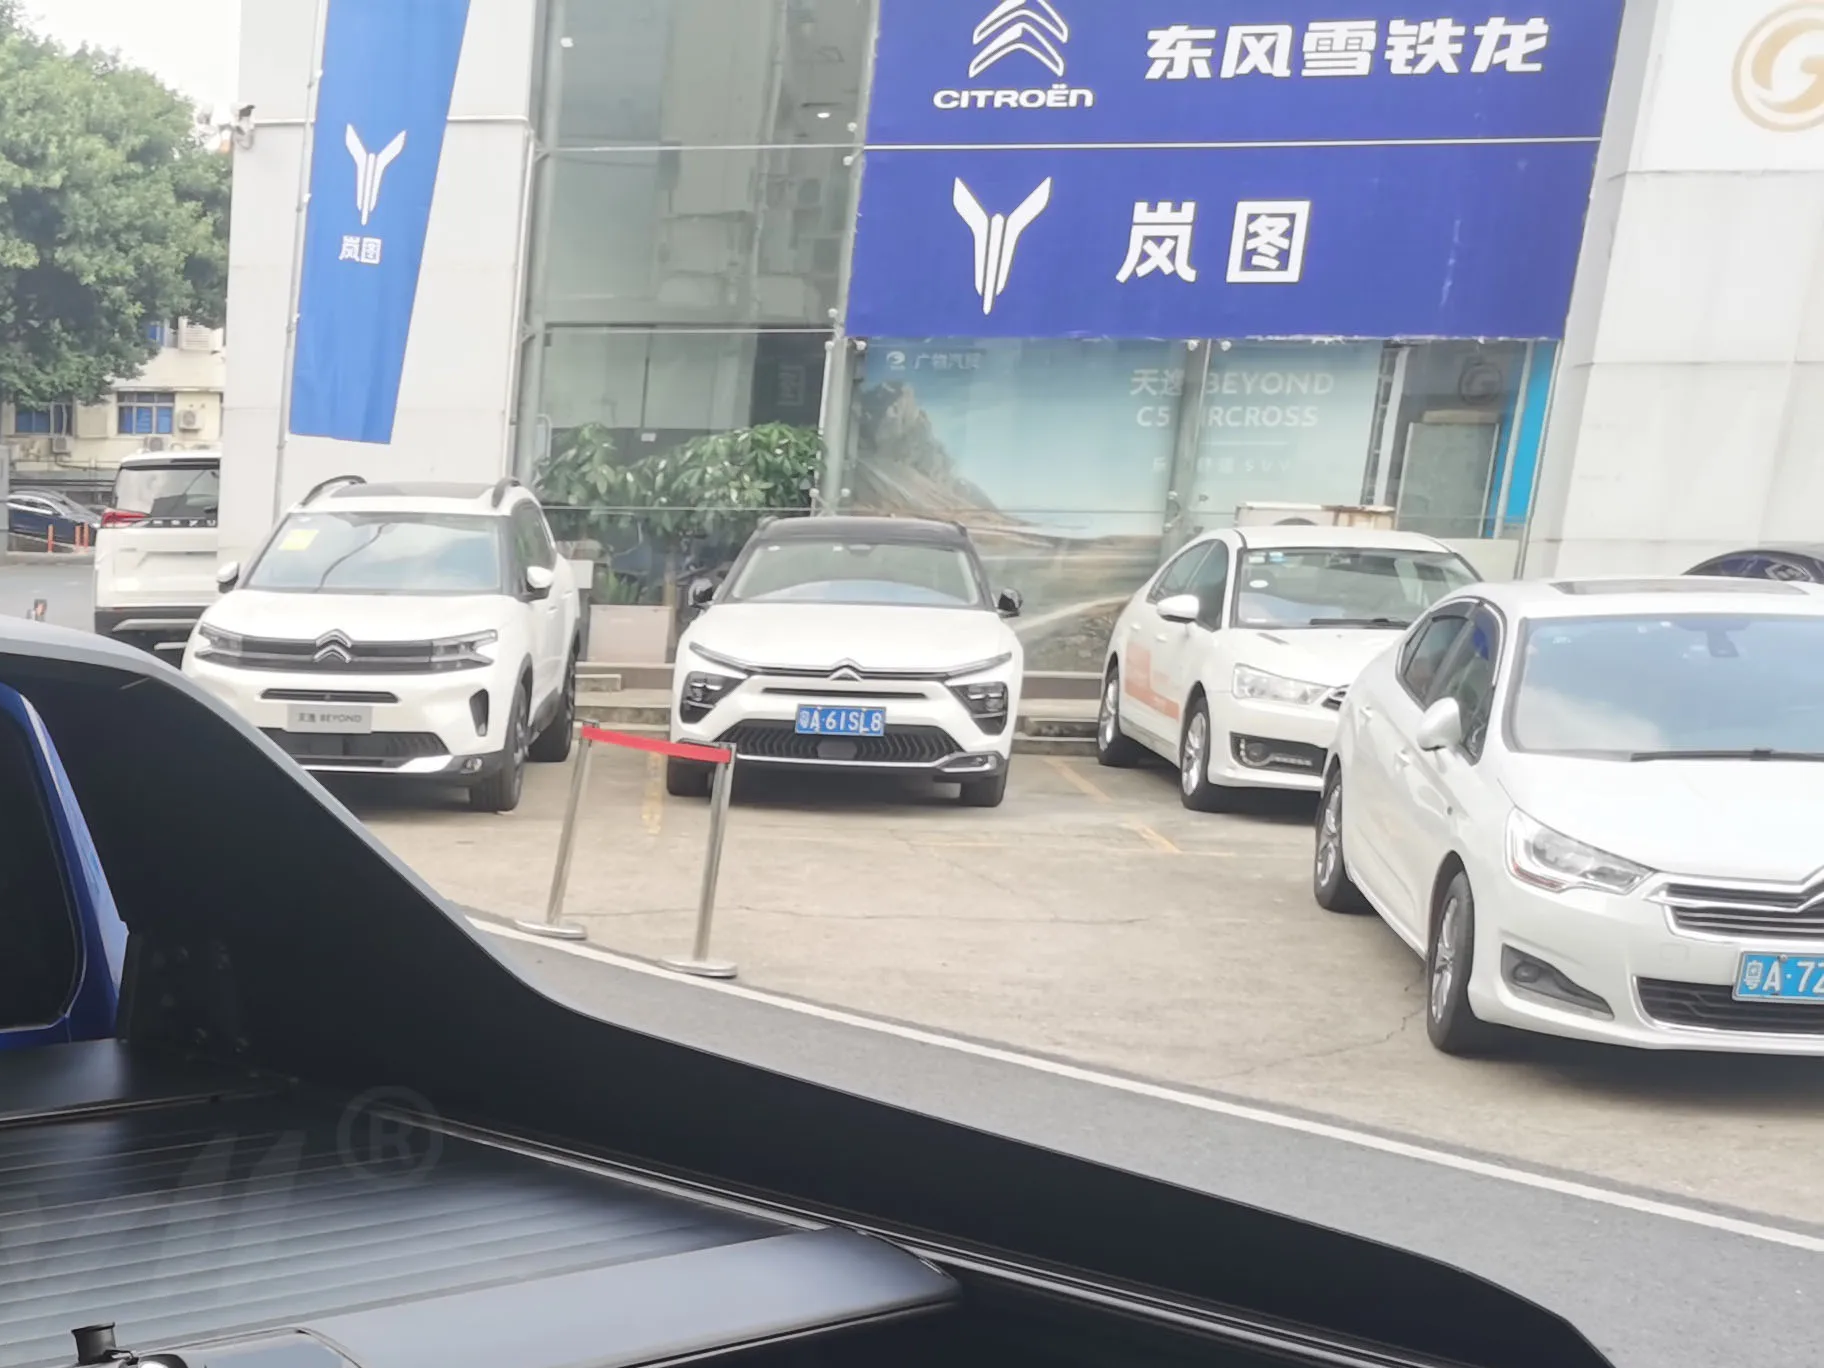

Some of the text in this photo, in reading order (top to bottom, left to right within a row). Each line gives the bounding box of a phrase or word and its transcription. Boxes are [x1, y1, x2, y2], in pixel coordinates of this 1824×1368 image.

[1145, 17, 1549, 79] 东风雪铁龙
[338, 234, 382, 264] 岚图
[1116, 201, 1311, 284] 岚图
[1136, 406, 1170, 427] C5
